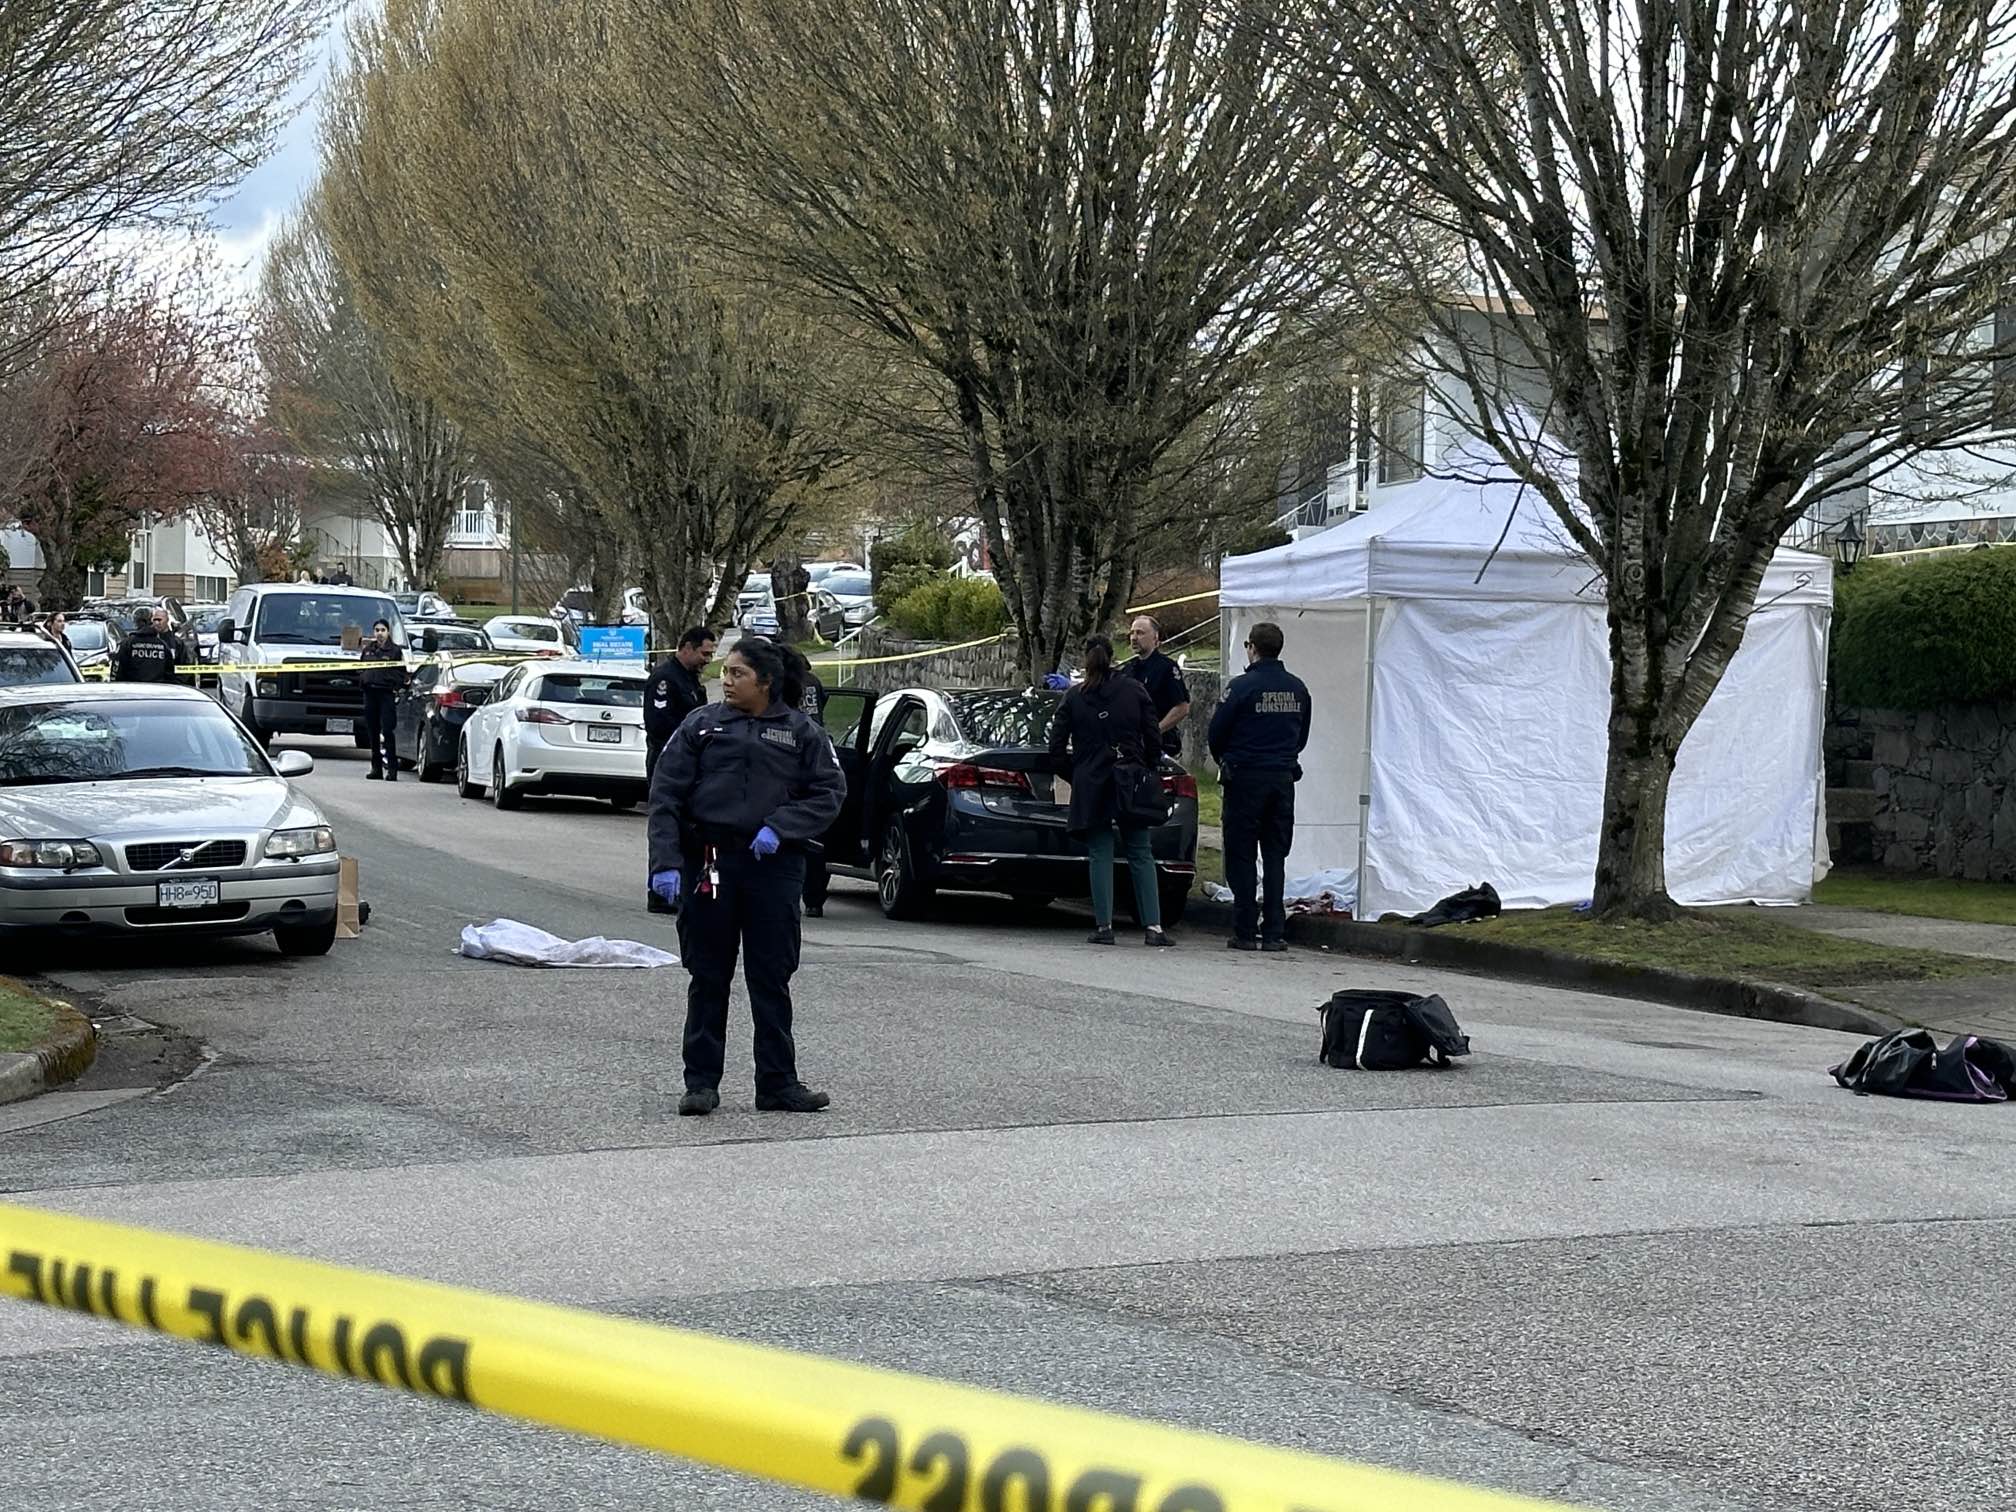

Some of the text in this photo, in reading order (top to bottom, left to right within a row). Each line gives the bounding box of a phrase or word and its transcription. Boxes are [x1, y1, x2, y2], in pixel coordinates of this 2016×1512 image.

[131, 649, 165, 660] POLICE
[1262, 691, 1295, 702] SPECIAL
[1255, 702, 1301, 713] CONSTABLE
